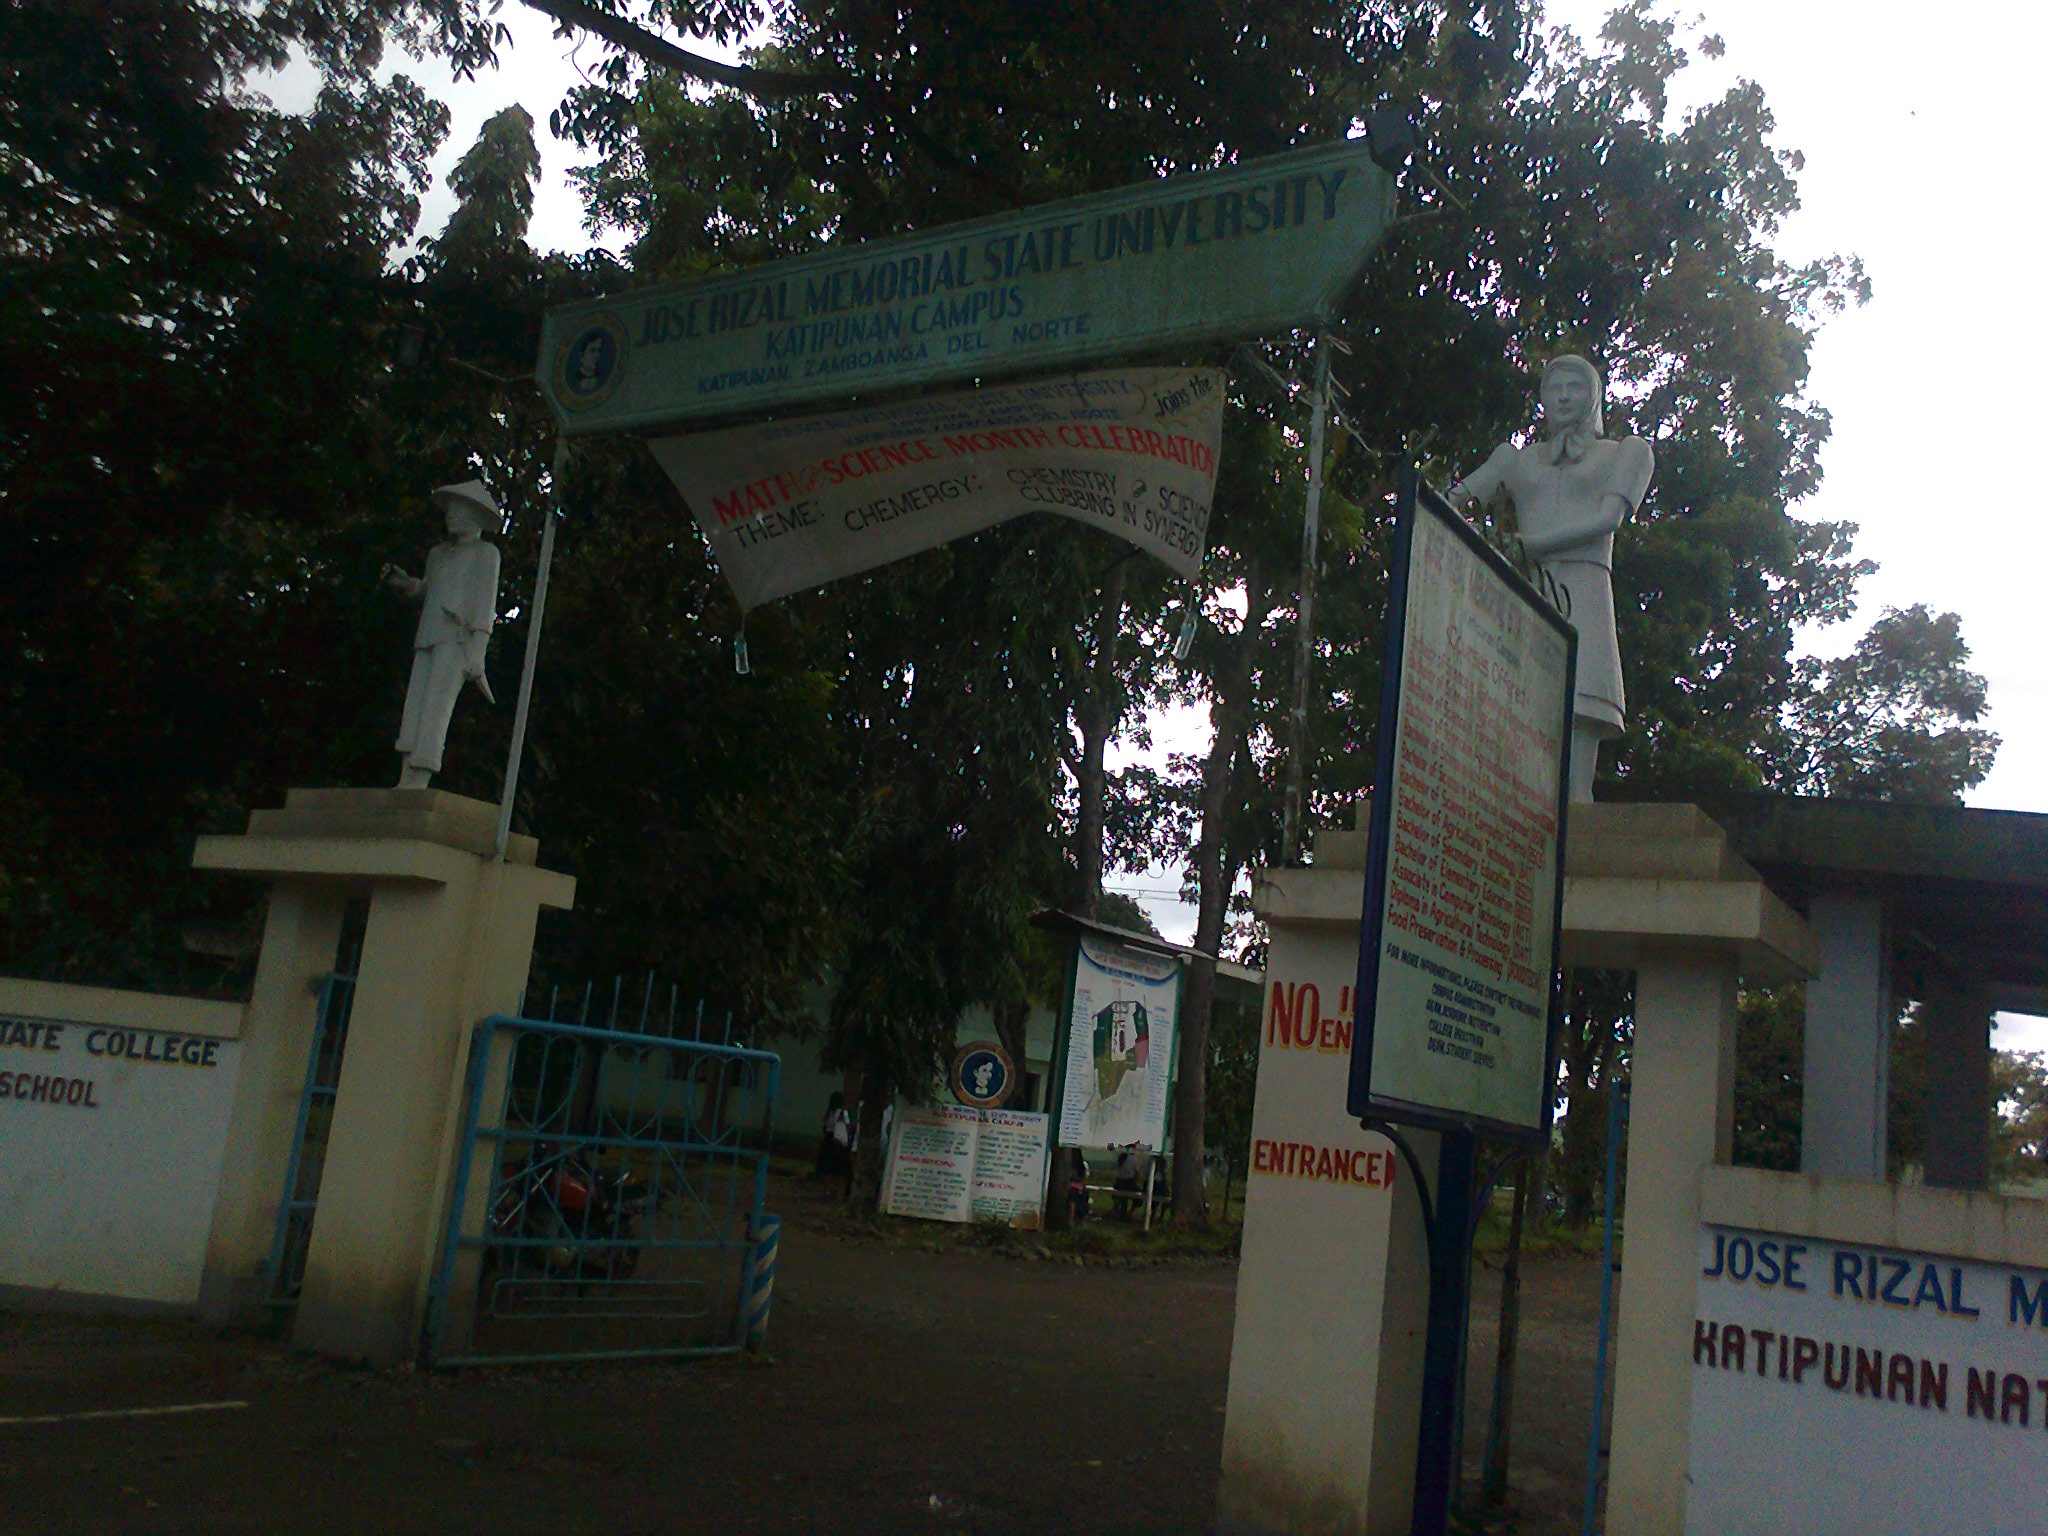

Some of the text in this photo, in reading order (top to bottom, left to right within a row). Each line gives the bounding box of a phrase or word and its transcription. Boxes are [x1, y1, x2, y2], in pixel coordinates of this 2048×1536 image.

[637, 170, 1348, 348] JOSE RIZAL MEMORIAL STATE UNIVERSITY
[699, 313, 1091, 395] KATIPUNAN ZAMBOANGA DEL NORTE
[766, 286, 1023, 360] KATIPUNAN CAMPUS
[711, 470, 803, 525] MATH
[822, 438, 940, 484] SCIENCE
[943, 427, 1052, 456] MONTH
[729, 502, 826, 548] THEME:
[1006, 467, 1117, 496] CHEMISTRY
[1020, 486, 1116, 518] CLUBBING
[1121, 500, 1137, 527] IN
[1395, 808, 1429, 844] Bachelor
[1430, 828, 1441, 851] of
[1397, 786, 1430, 822] Bachelor
[1431, 805, 1441, 828] of
[1392, 855, 1430, 893] Associate
[1393, 831, 1427, 867] Bachelor
[1427, 850, 1438, 873] of
[1439, 856, 1480, 900] Elementary
[1387, 903, 1408, 931] Food
[1408, 912, 1457, 954] Preservation
[1459, 938, 1466, 957] &
[1466, 940, 1503, 982] Processing
[1389, 879, 1420, 915] Diploma
[1420, 895, 1428, 916] in
[1429, 899, 1473, 940] Agricultural
[1475, 922, 1510, 961] Technology
[1385, 941, 1399, 961] FOR
[1400, 948, 1419, 969] MORE
[86, 1029, 220, 1066] COLLEGE
[1267, 981, 1320, 1048] NO
[0, 1071, 98, 1107] SCHOOL
[1254, 1139, 1382, 1185] ENTRANCE
[1703, 1235, 2048, 1327] JOSE RIZAL M
[1693, 1319, 1948, 1411] KATIPUNAN
